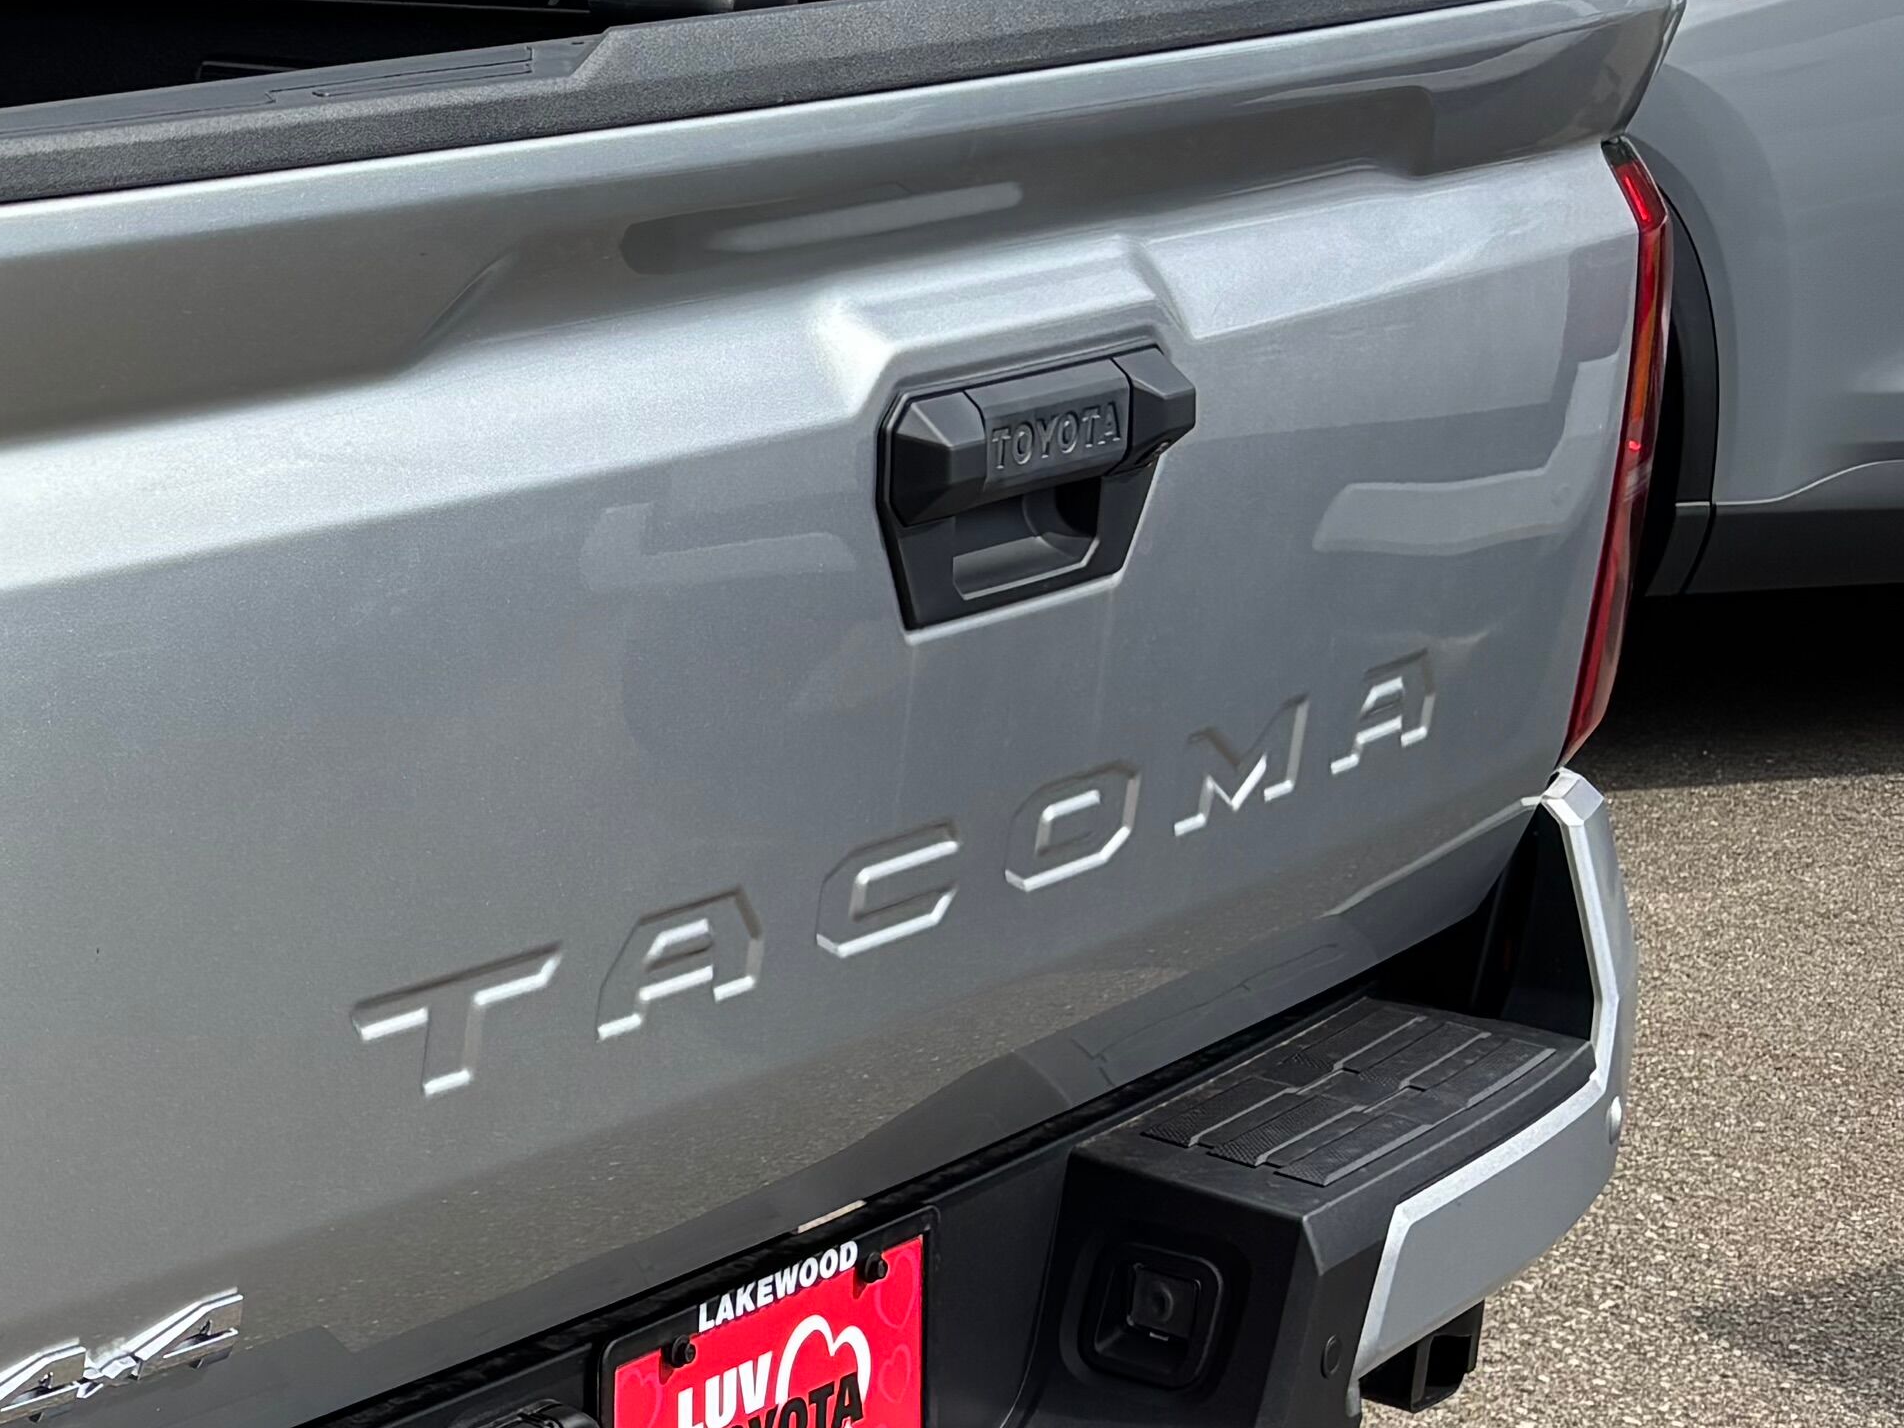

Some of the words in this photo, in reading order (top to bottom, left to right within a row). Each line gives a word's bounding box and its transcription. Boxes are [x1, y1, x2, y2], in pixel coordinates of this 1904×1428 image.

[991, 400, 1122, 471] TOYOTA
[349, 646, 1439, 1099] TACOMA
[697, 1239, 859, 1333] LAKEWOOD
